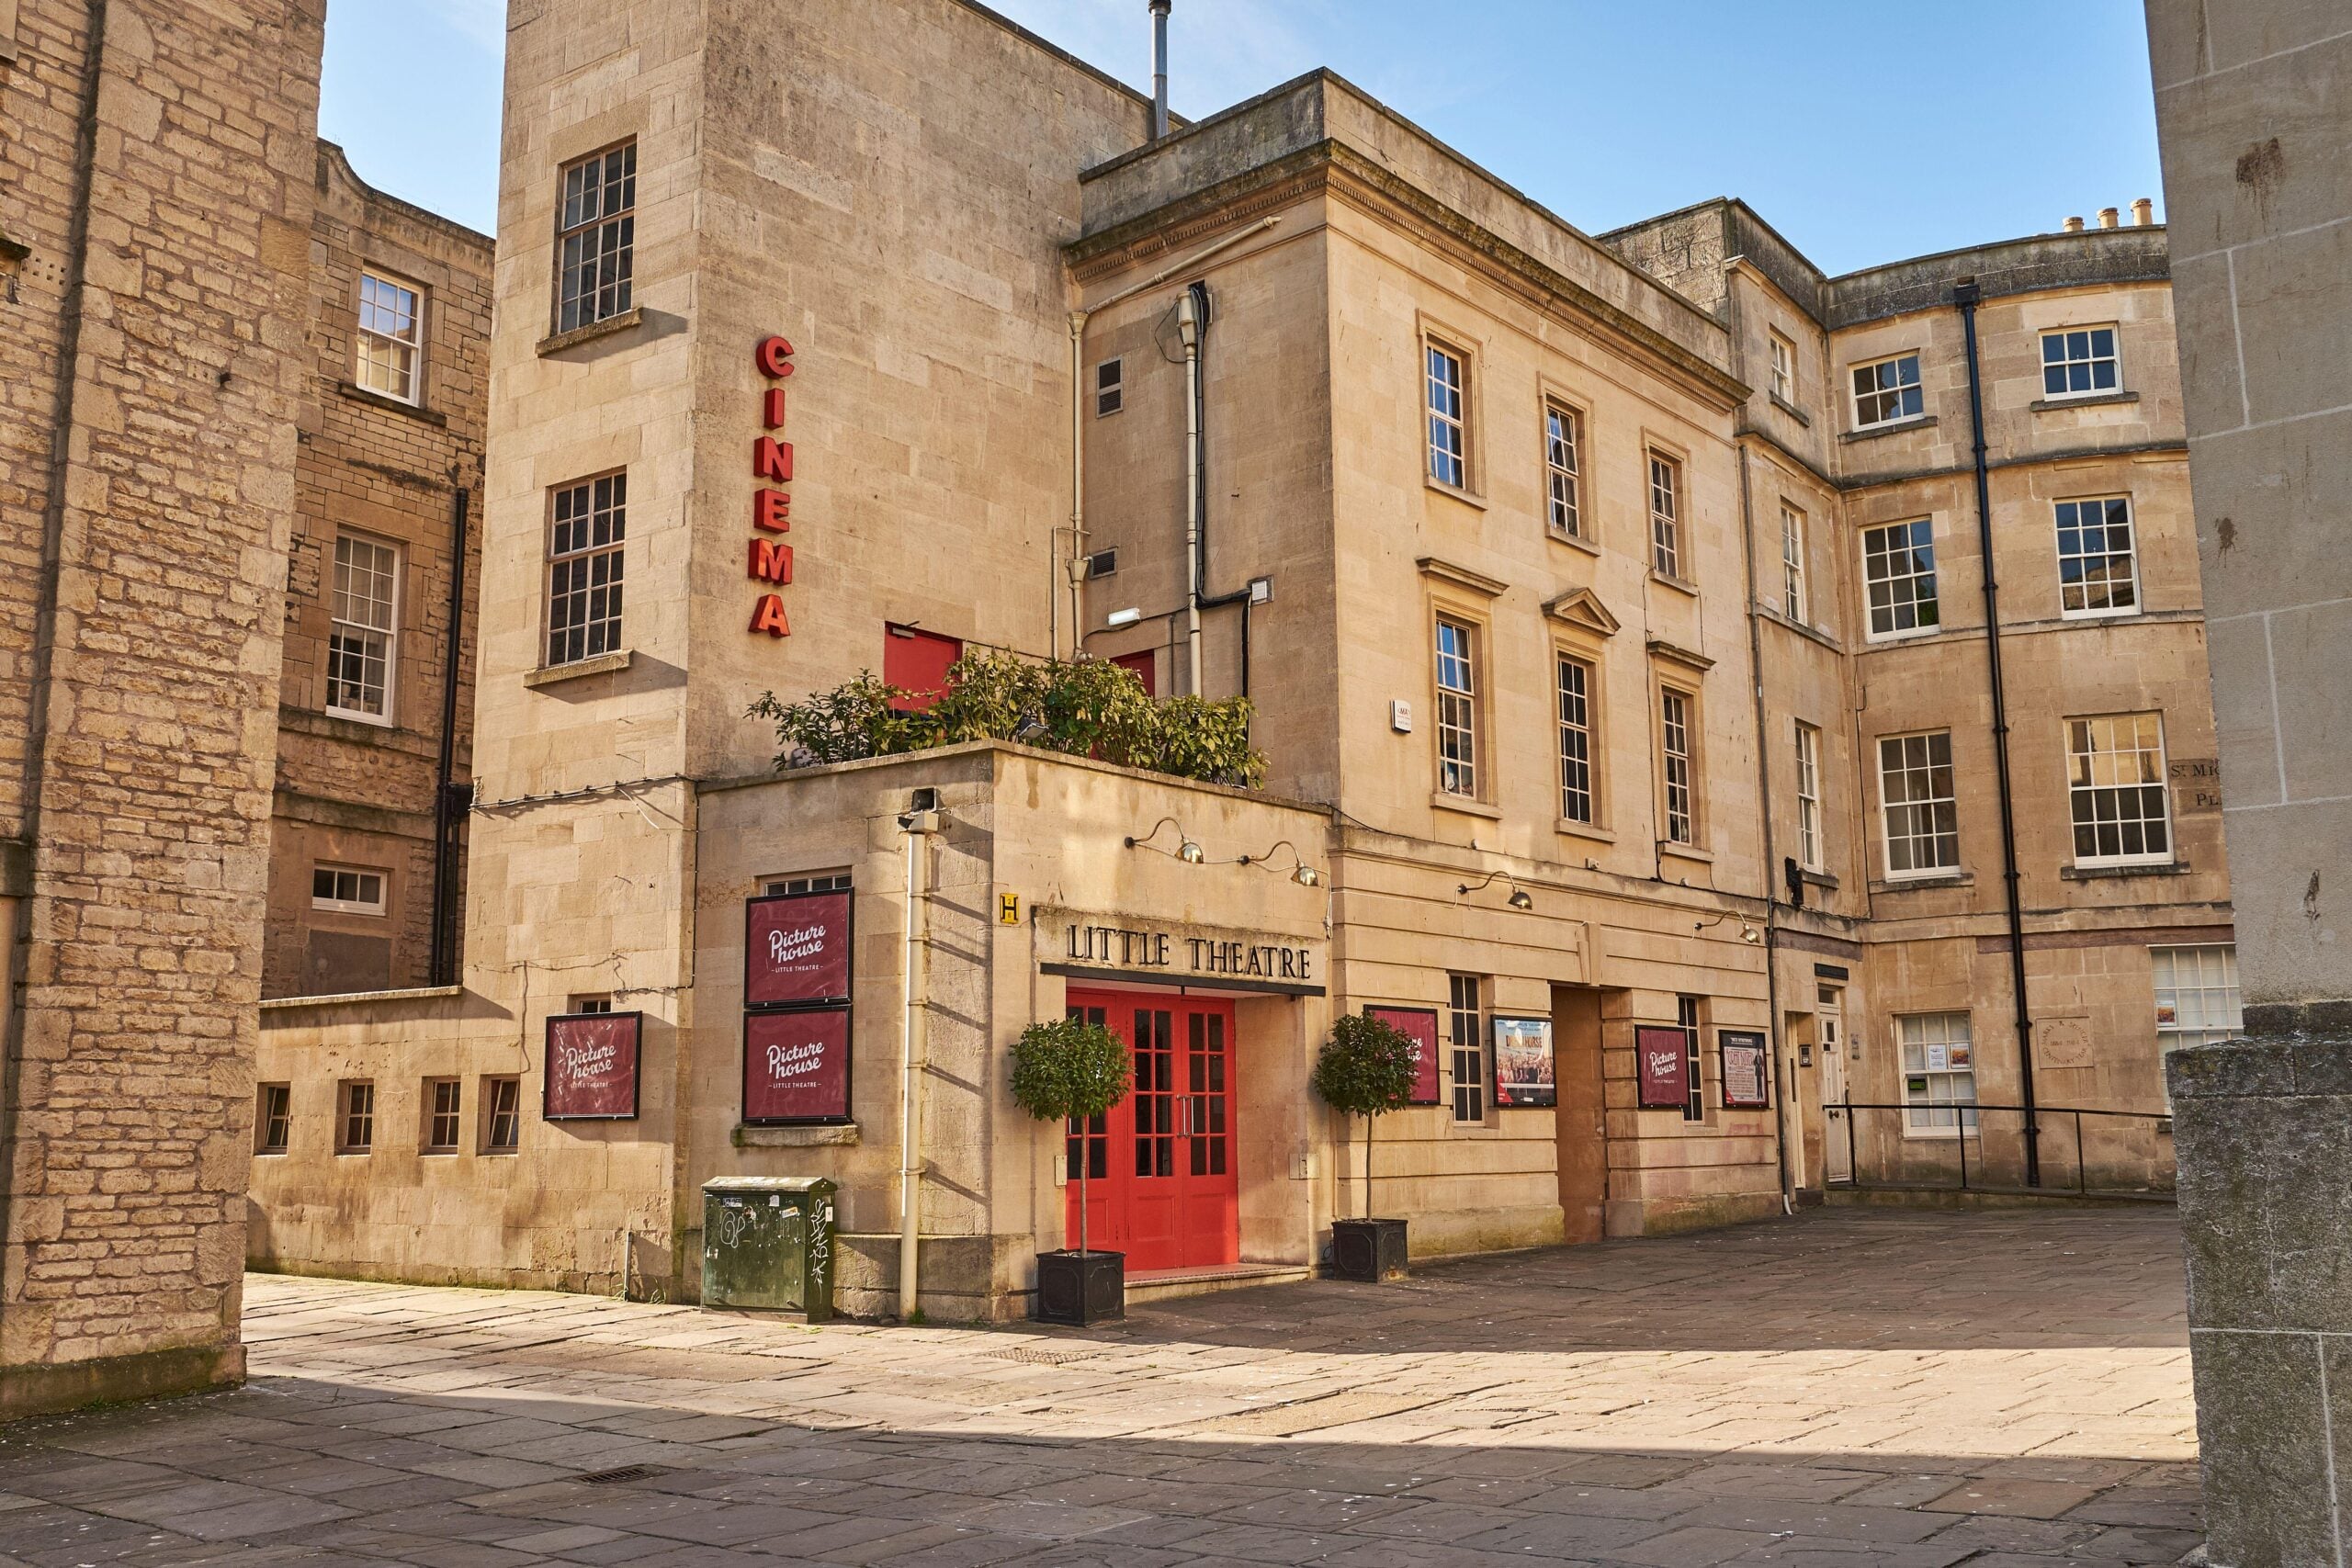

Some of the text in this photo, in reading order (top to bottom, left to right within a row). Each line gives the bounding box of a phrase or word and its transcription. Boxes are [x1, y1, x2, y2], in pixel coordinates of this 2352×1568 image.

[748, 336, 795, 638] CINEMA
[2197, 794, 2222, 806] PL
[1001, 896, 1018, 920] H
[769, 925, 826, 959] Picture
[777, 940, 824, 964] house
[1068, 924, 1311, 979] LITTLE THEATRE
[565, 1044, 616, 1075] Picture
[766, 1042, 825, 1074] Picture
[775, 1057, 821, 1079] house
[1650, 1052, 1678, 1074] Picture
[1655, 1063, 1677, 1077] house
